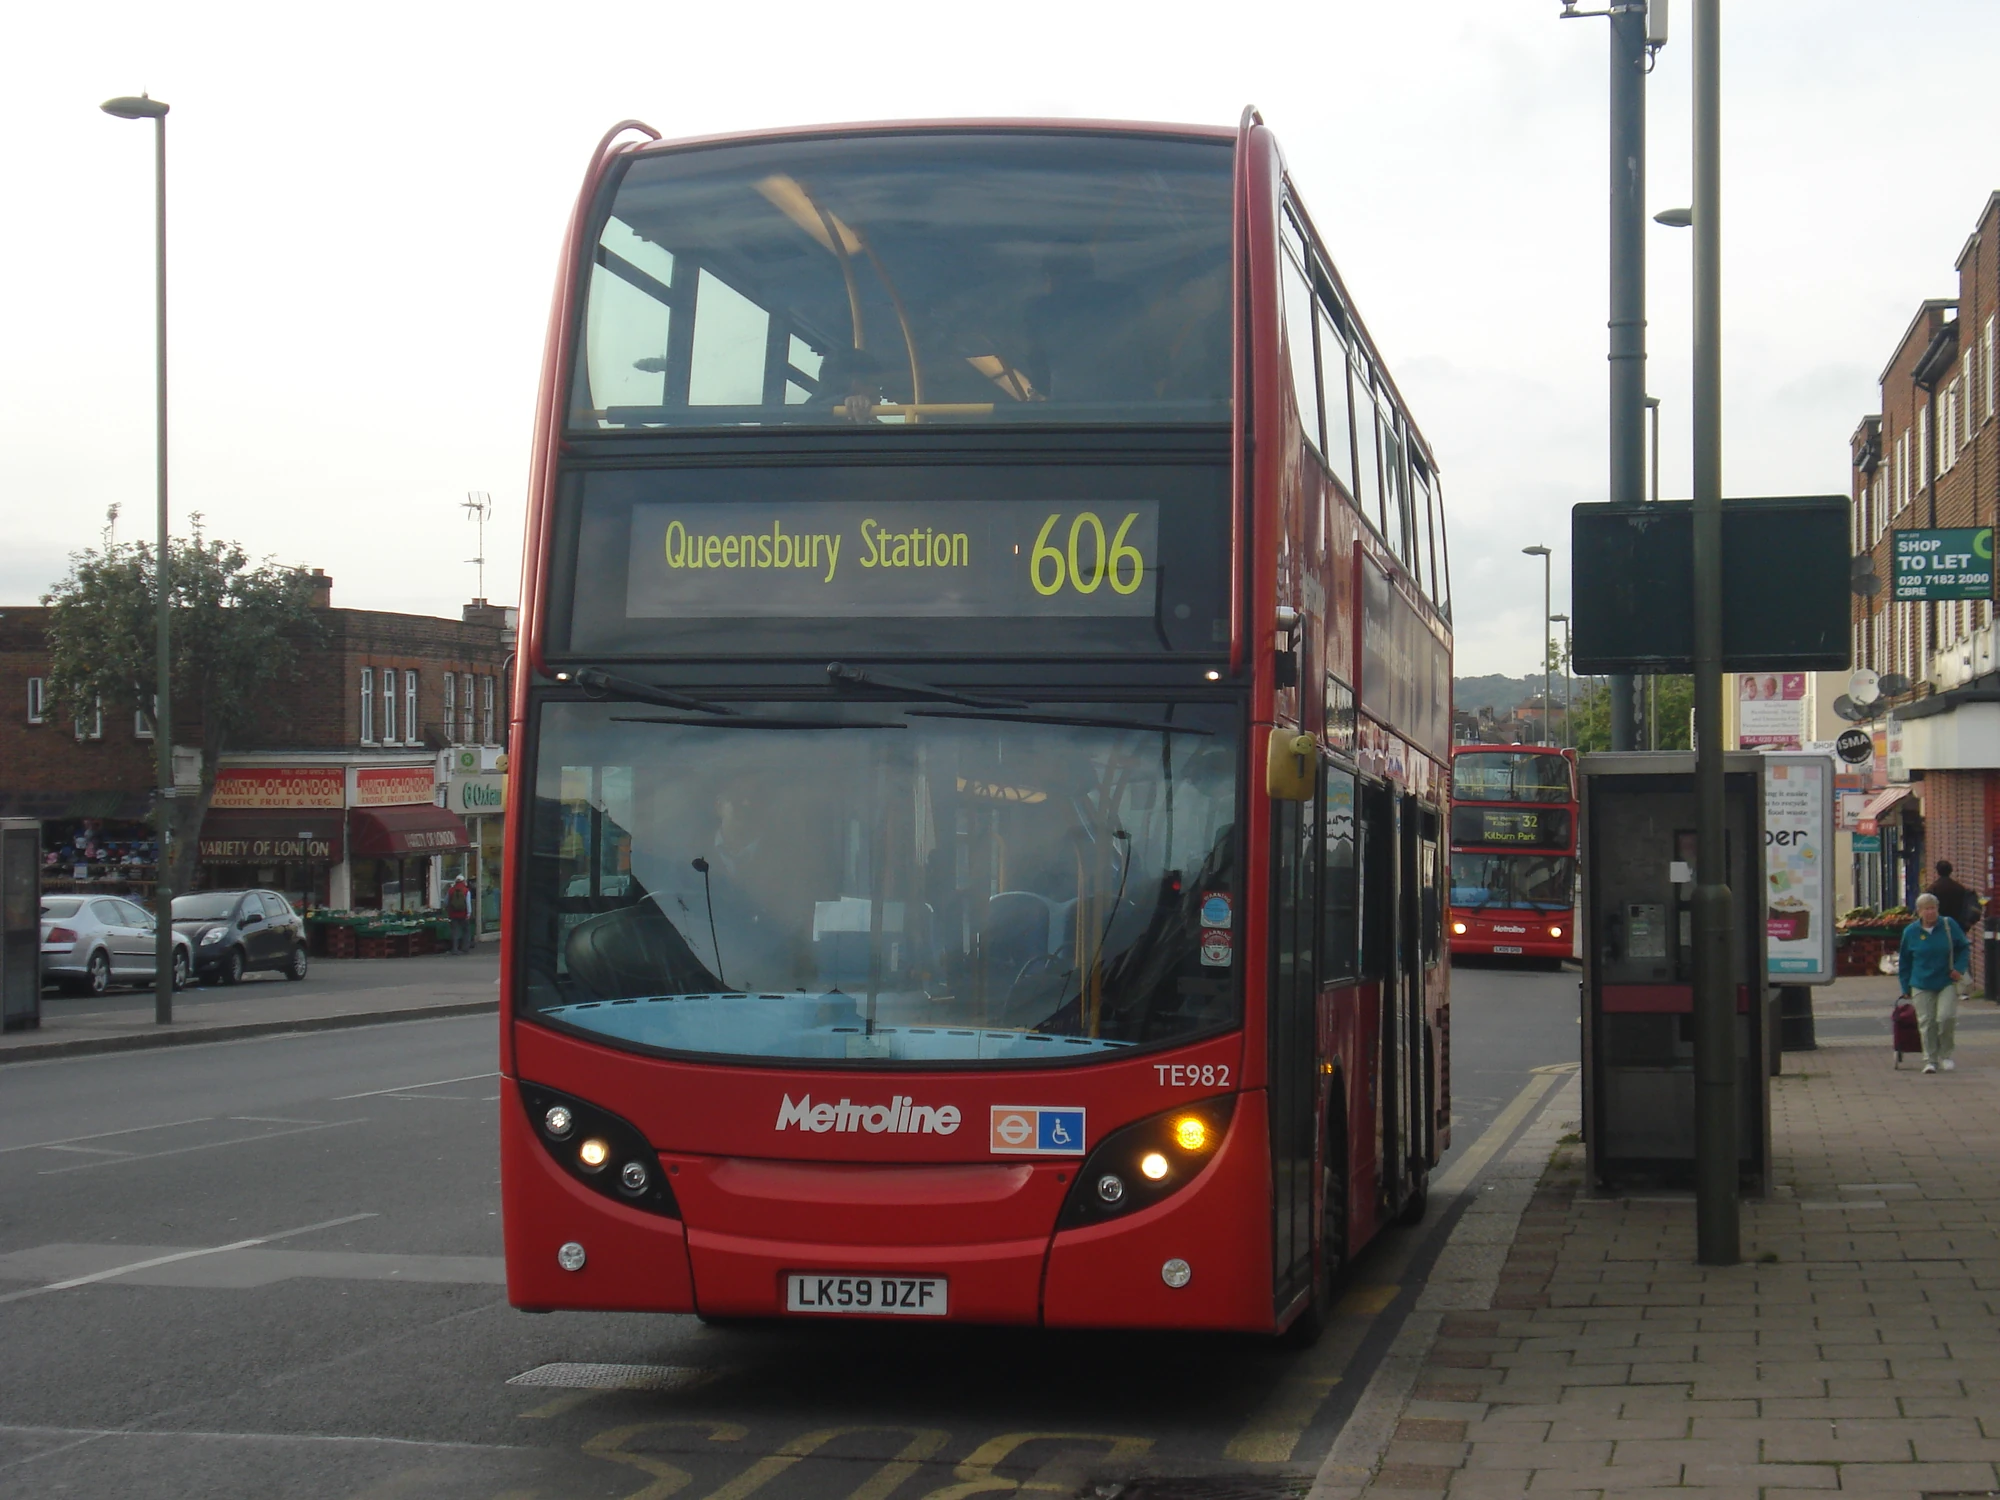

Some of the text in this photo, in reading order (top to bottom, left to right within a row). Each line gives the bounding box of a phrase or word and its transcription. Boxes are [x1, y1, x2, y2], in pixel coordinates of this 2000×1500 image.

[665, 518, 969, 583] Queensbury Station
[1030, 511, 1145, 596] 606
[1898, 539, 1941, 553] SHOP
[1898, 553, 1971, 571] TO LET
[1898, 573, 1989, 586] 020 7182 2000
[1896, 586, 1927, 596] CBRE
[1837, 734, 1869, 750] ISMA
[265, 778, 283, 796] OF
[286, 778, 341, 796] LONDON
[360, 778, 388, 795] VARIETY
[401, 776, 431, 793] LONDON
[215, 798, 255, 806] EXOTIC
[260, 798, 290, 806] FRUIT
[1522, 815, 1538, 828] 32
[1484, 831, 1536, 840] Kilburn Park
[200, 840, 249, 856] VARIETY
[253, 840, 271, 856] OF
[1204, 892, 1232, 904] WARNING
[1204, 929, 1232, 941] WARNING
[1492, 924, 1526, 934] Metroline
[1153, 1064, 1230, 1087] TE982
[774, 1092, 962, 1136] Metroline
[798, 1278, 936, 1308] LK59 DZF
